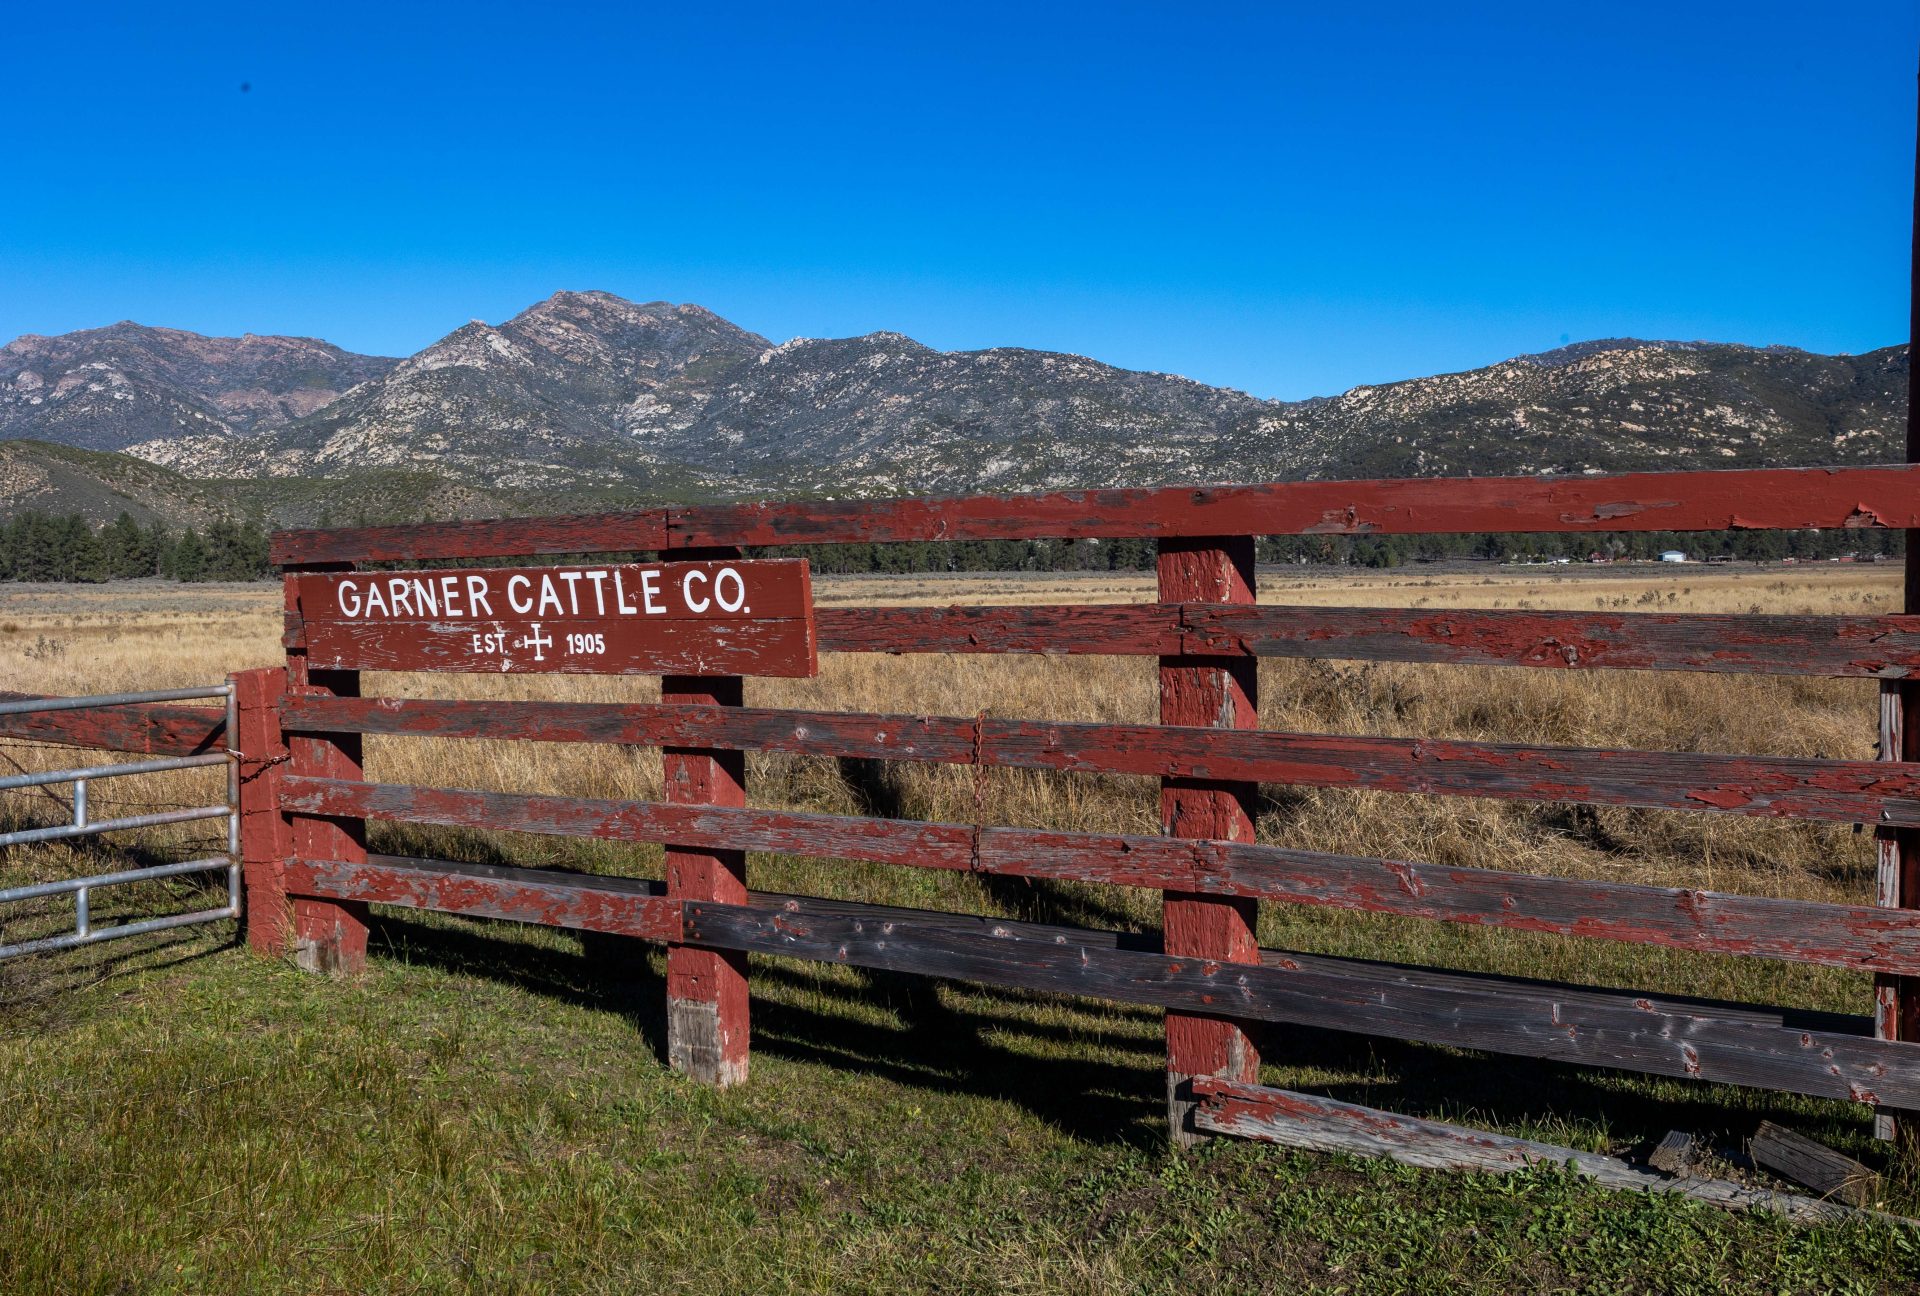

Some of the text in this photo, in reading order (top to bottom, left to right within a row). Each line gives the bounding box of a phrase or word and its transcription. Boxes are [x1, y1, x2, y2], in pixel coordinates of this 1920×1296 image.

[338, 567, 751, 618] GARNER CATTLE CO.
[473, 633, 606, 655] EST. 1905
